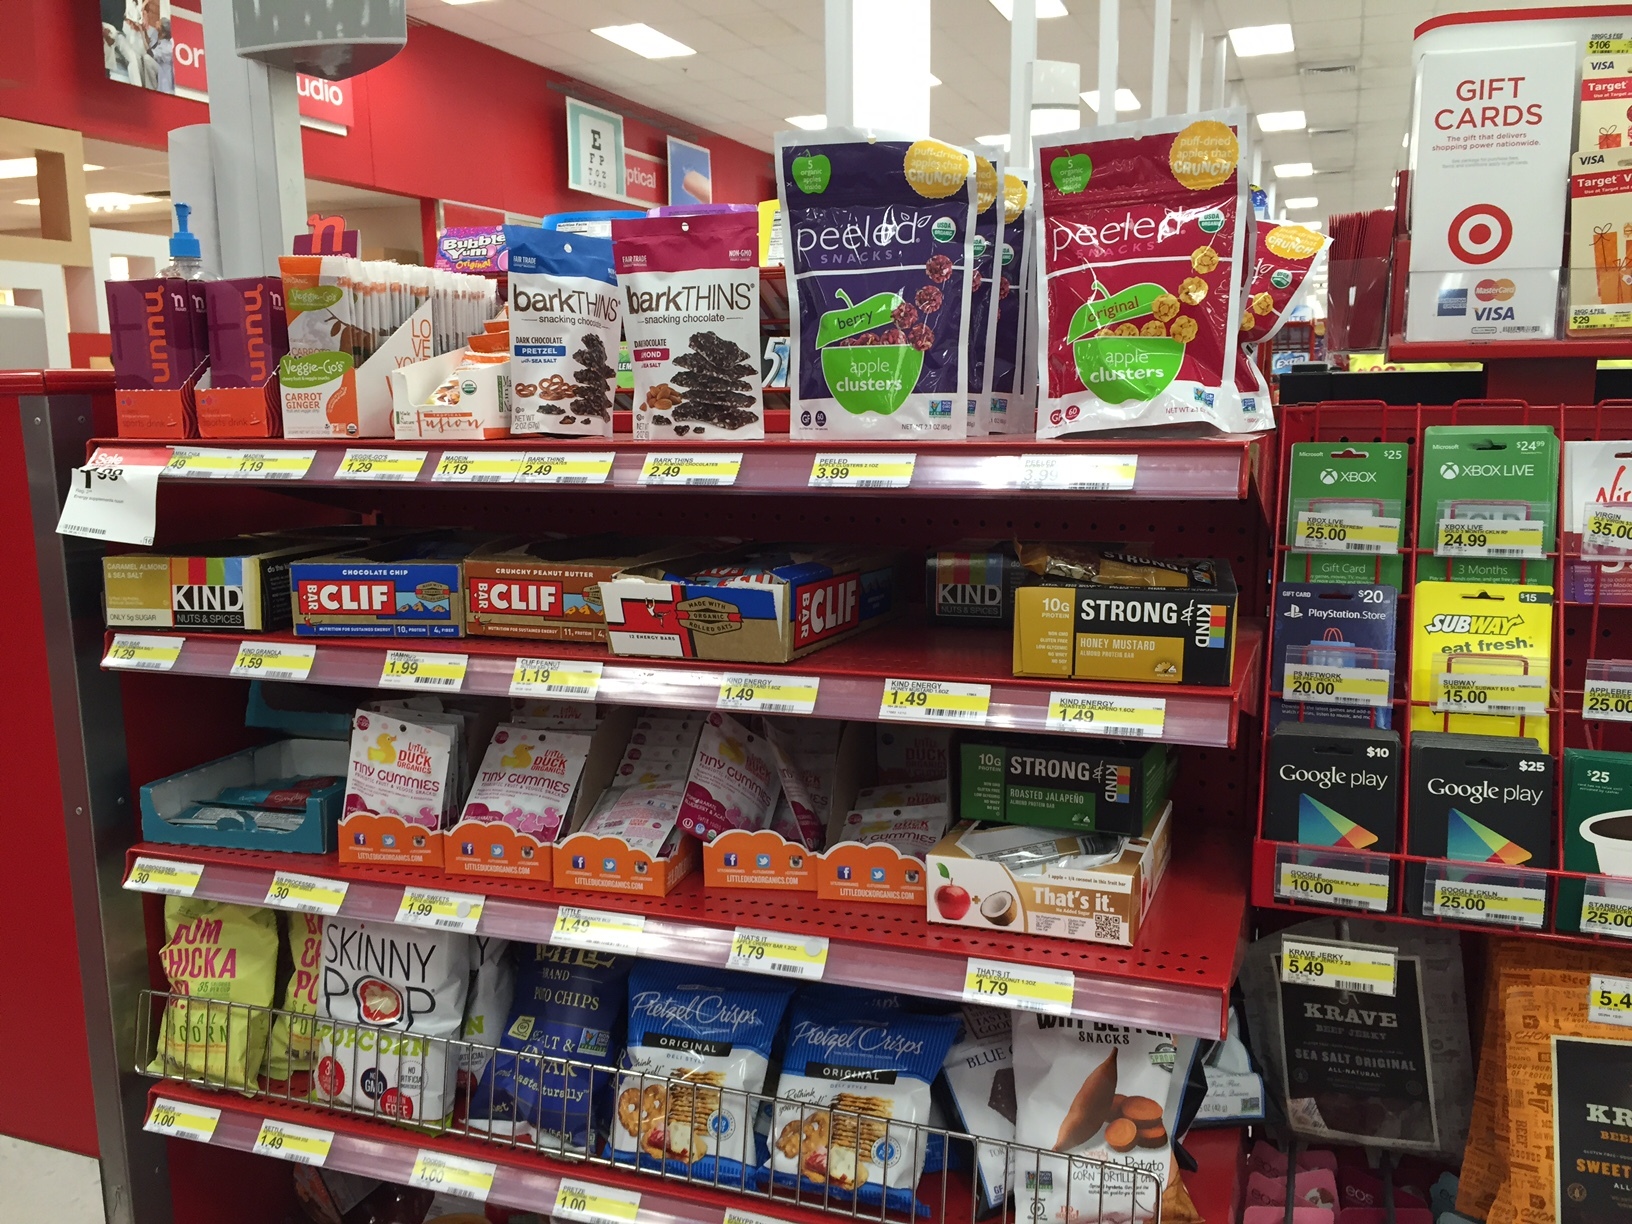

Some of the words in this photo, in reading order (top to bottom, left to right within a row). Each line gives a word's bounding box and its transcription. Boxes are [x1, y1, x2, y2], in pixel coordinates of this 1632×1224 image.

[1588, 40, 1610, 49] $106
[1591, 61, 1614, 70] VISA
[1456, 77, 1526, 101] GIFT
[1588, 81, 1627, 91] Target
[1434, 103, 1543, 130] CARDS
[1463, 133, 1477, 142] gift
[1496, 131, 1527, 140] delivers
[1176, 149, 1209, 161] apples
[1211, 147, 1232, 158] that
[1579, 155, 1605, 165] VISA
[800, 169, 823, 178] organic
[1173, 160, 1231, 176] CRUNCH
[803, 176, 822, 184] apples
[446, 247, 488, 258] Yum
[728, 249, 752, 257] NON-GMO
[455, 259, 491, 270] Original
[1475, 285, 1515, 295] MasterCard
[1087, 296, 1140, 323] original
[1473, 306, 1515, 321] VISA
[644, 314, 680, 325] snacking
[682, 313, 725, 323] chocolate
[837, 310, 873, 331] berry
[1572, 316, 1590, 324] $29
[515, 336, 530, 344] DARK
[530, 336, 563, 344] CHOCOLATE
[521, 347, 558, 355] PRETZEL
[1105, 351, 1149, 368] apple
[850, 358, 890, 376] apple
[1089, 366, 1164, 384] clusters
[836, 377, 902, 392] clusters
[285, 392, 322, 401] CARROT
[286, 401, 320, 409] GINGER
[95, 453, 124, 466] Sale
[1383, 450, 1402, 460] $25
[238, 461, 264, 473] 1.19
[346, 462, 372, 473] 1.29
[440, 464, 468, 475] 1.19
[522, 465, 552, 476] 2.49
[649, 466, 680, 477] 2.49
[815, 467, 849, 479] 3.99
[1462, 464, 1502, 476] XBOX
[1503, 464, 1534, 476] LIVE
[1340, 471, 1377, 483] XBOX
[1595, 511, 1622, 520] VIRGIN
[1305, 526, 1347, 541] 25.00
[1444, 533, 1487, 547] 24.99
[139, 563, 168, 571] ALMOND
[532, 569, 563, 577] PEANUT
[564, 570, 594, 578] BUTTER
[1321, 563, 1342, 573] Gift
[1343, 563, 1366, 573] Card
[1458, 564, 1466, 574] 3
[1467, 564, 1508, 575] Months
[173, 585, 243, 611] KIND
[319, 584, 388, 611] CLIF
[489, 584, 556, 611] CLIF
[937, 584, 1000, 606] KIND
[1282, 590, 1294, 598] GIFT
[1520, 593, 1537, 603] $15
[810, 579, 857, 633] CLIF
[1080, 599, 1178, 624] STRONG
[177, 615, 200, 623] NUTS
[201, 615, 208, 623] &
[210, 615, 242, 624] SPICES
[1308, 608, 1361, 619] PlayStation
[1362, 611, 1386, 621] Store
[1195, 603, 1211, 648] KIND
[1425, 614, 1524, 635] SUBWAY
[1080, 637, 1109, 649] HONEY
[1112, 639, 1155, 651] MUSTARD
[1441, 643, 1474, 655] eat
[1478, 636, 1534, 652] fresh.
[112, 649, 135, 660] 1.29
[238, 657, 263, 669] 1.59
[389, 661, 419, 675] 1.99
[519, 668, 550, 683] 1.19
[911, 682, 942, 690] ENERGY
[1292, 681, 1335, 696] 20.00
[724, 687, 754, 701] 1.49
[890, 691, 927, 706] 1.49
[1443, 690, 1487, 704] 15.00
[1059, 698, 1078, 706] KIND
[1080, 699, 1114, 707] ENERGY
[1059, 709, 1094, 724] 1.49
[398, 749, 432, 768] DUCK
[1366, 746, 1389, 758] $10
[534, 756, 568, 769] DUCK
[1010, 755, 1090, 781] STRONG
[1518, 760, 1545, 772] $25
[531, 765, 566, 776] ORGANICS
[1587, 769, 1610, 783] $25
[1279, 764, 1347, 790] Google
[1351, 769, 1388, 791] play
[1427, 778, 1499, 804] Google
[1503, 784, 1544, 806] play
[1290, 869, 1323, 878] GOOGLE
[1291, 878, 1333, 895] 10.00
[1441, 886, 1474, 895] GOOGLE
[407, 902, 432, 917] 1.99
[1440, 895, 1486, 911] 25.00
[560, 908, 582, 916] LITTLE
[737, 933, 759, 941] THAT'S
[735, 945, 765, 959] 1.79
[1289, 948, 1313, 958] KRAVE
[1314, 952, 1344, 961] JERKY
[976, 967, 1001, 976] THAT'S
[1002, 969, 1011, 977] IT
[1288, 960, 1324, 976] 5.49
[974, 978, 1008, 997] 1.79
[1303, 1003, 1398, 1028] KRAVE
[1078, 1030, 1130, 1045] SNACKS
[1315, 1024, 1344, 1035] BEEF
[1348, 1028, 1387, 1041] JERKY
[659, 1036, 717, 1053] ORIGINAL
[966, 1049, 1003, 1069] BLUE
[1295, 1048, 1319, 1061] SEA
[1322, 1050, 1351, 1065] SALT
[1355, 1054, 1416, 1072] ORIGINAL
[152, 1113, 175, 1128] 1.00
[260, 1134, 283, 1149] 1.49
[1576, 1158, 1631, 1178] SWEET
[1072, 1170, 1095, 1181] CORN
[560, 1196, 586, 1212] 1.00
